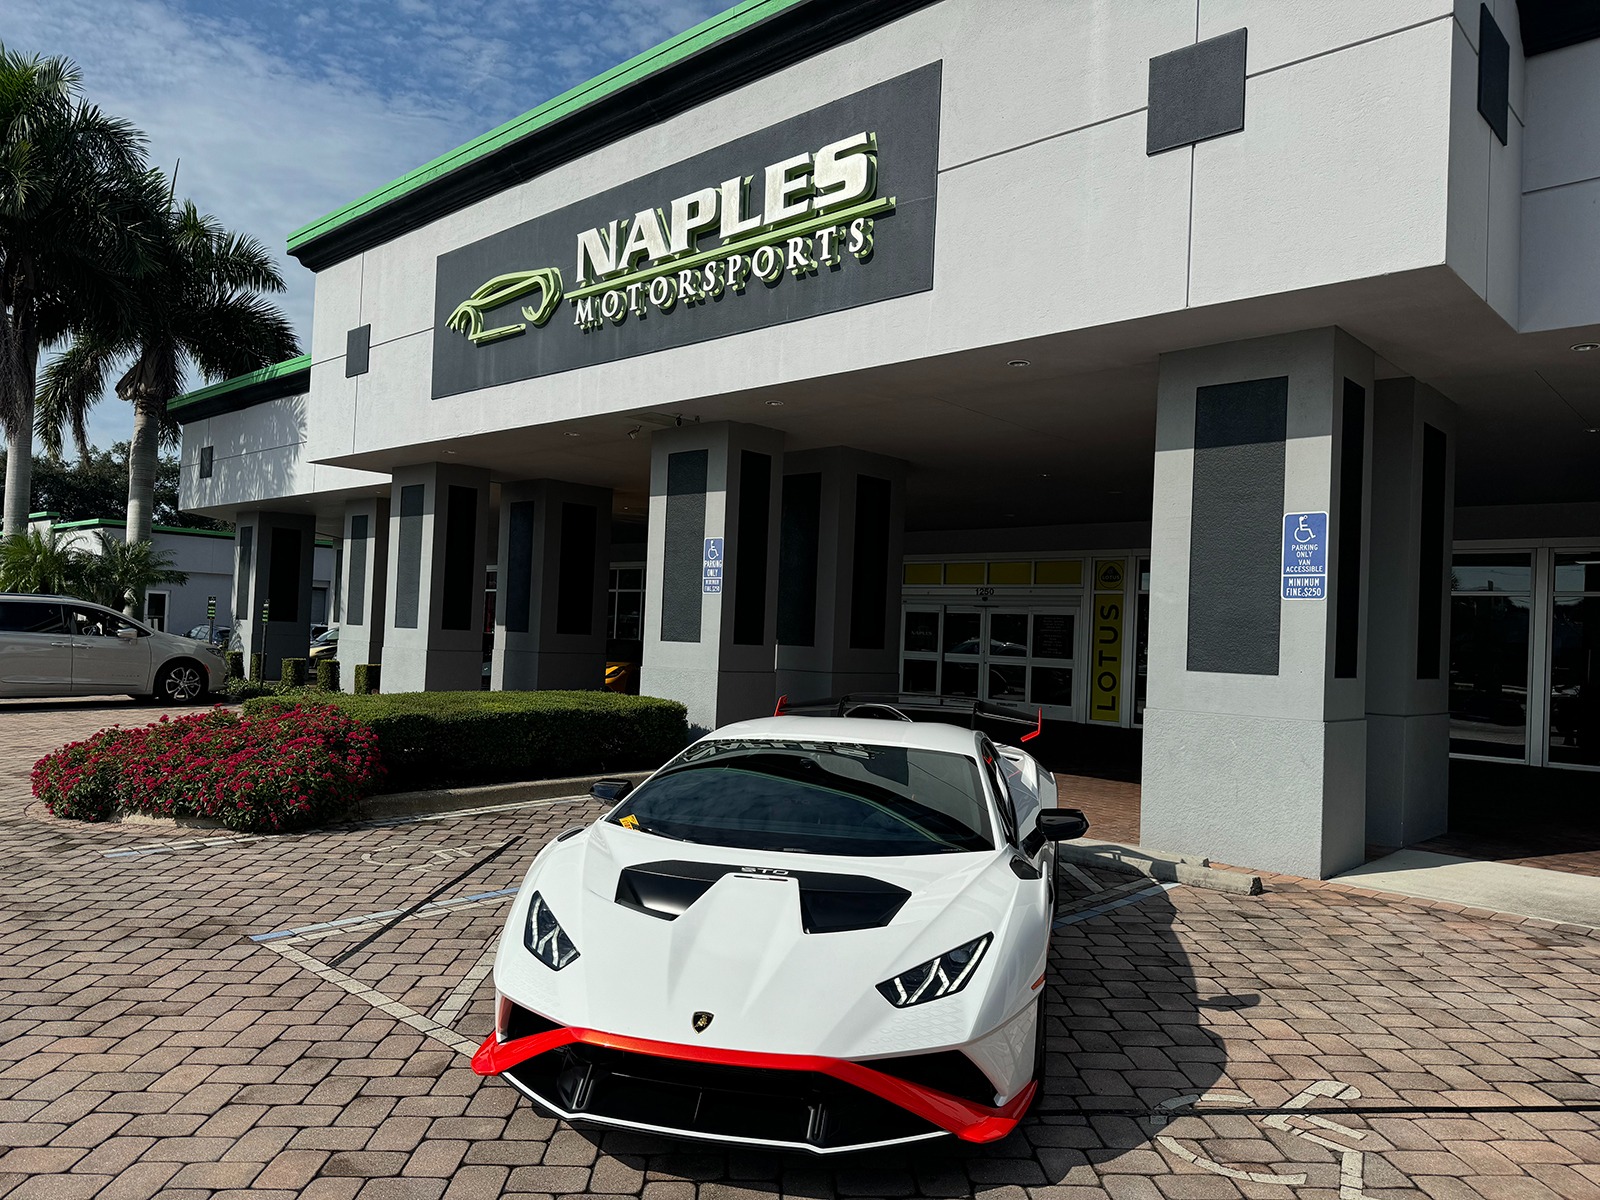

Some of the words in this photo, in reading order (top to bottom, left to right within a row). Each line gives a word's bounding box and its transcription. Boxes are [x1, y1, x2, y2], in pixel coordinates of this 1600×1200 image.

[575, 131, 874, 285] NAPLES
[574, 218, 871, 327] MOTORSPORTS
[1101, 574, 1120, 582] LOTUS
[1288, 578, 1320, 587] MINIMUM
[975, 587, 995, 596] 1250
[1096, 604, 1120, 712] LOTUS
[741, 866, 790, 876] STO
